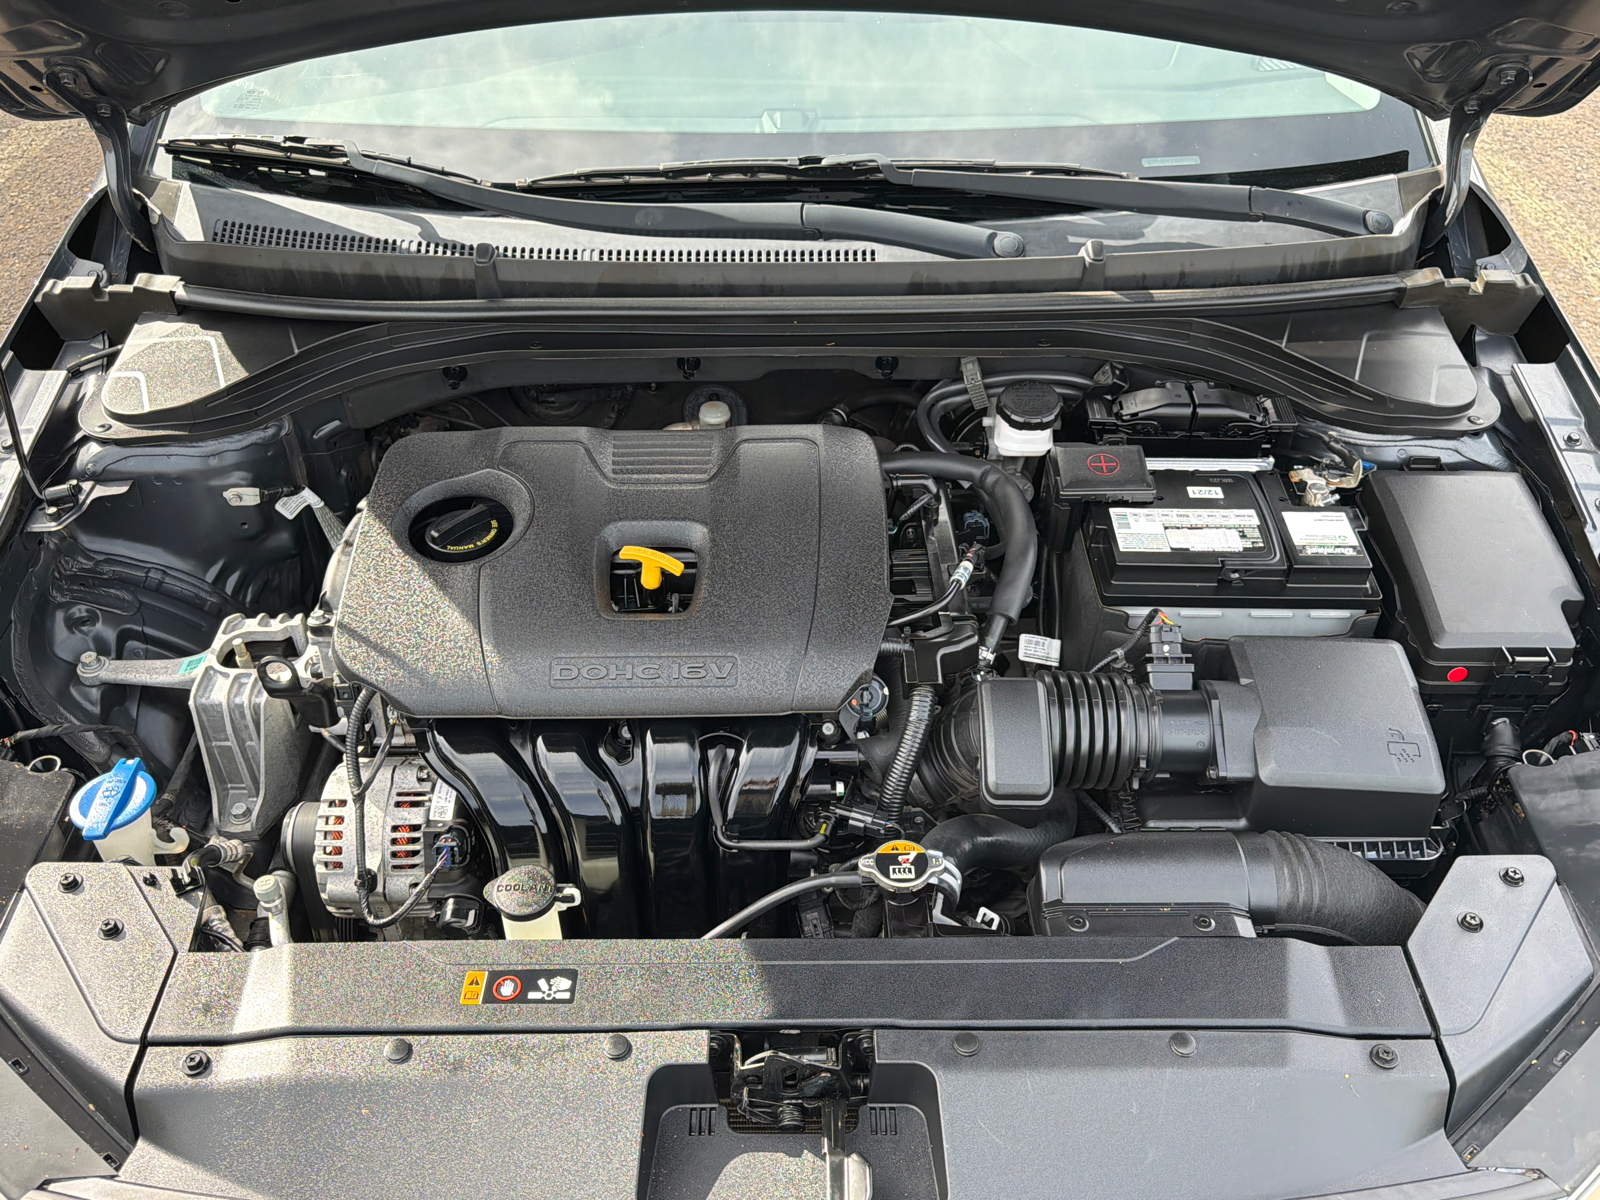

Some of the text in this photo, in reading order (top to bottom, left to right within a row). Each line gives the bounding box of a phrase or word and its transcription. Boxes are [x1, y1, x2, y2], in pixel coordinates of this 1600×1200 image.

[491, 519, 499, 528] SEE
[1305, 546, 1357, 555] Duralast
[553, 662, 736, 681] DOHC 16V
[496, 882, 553, 894] COOLANT
